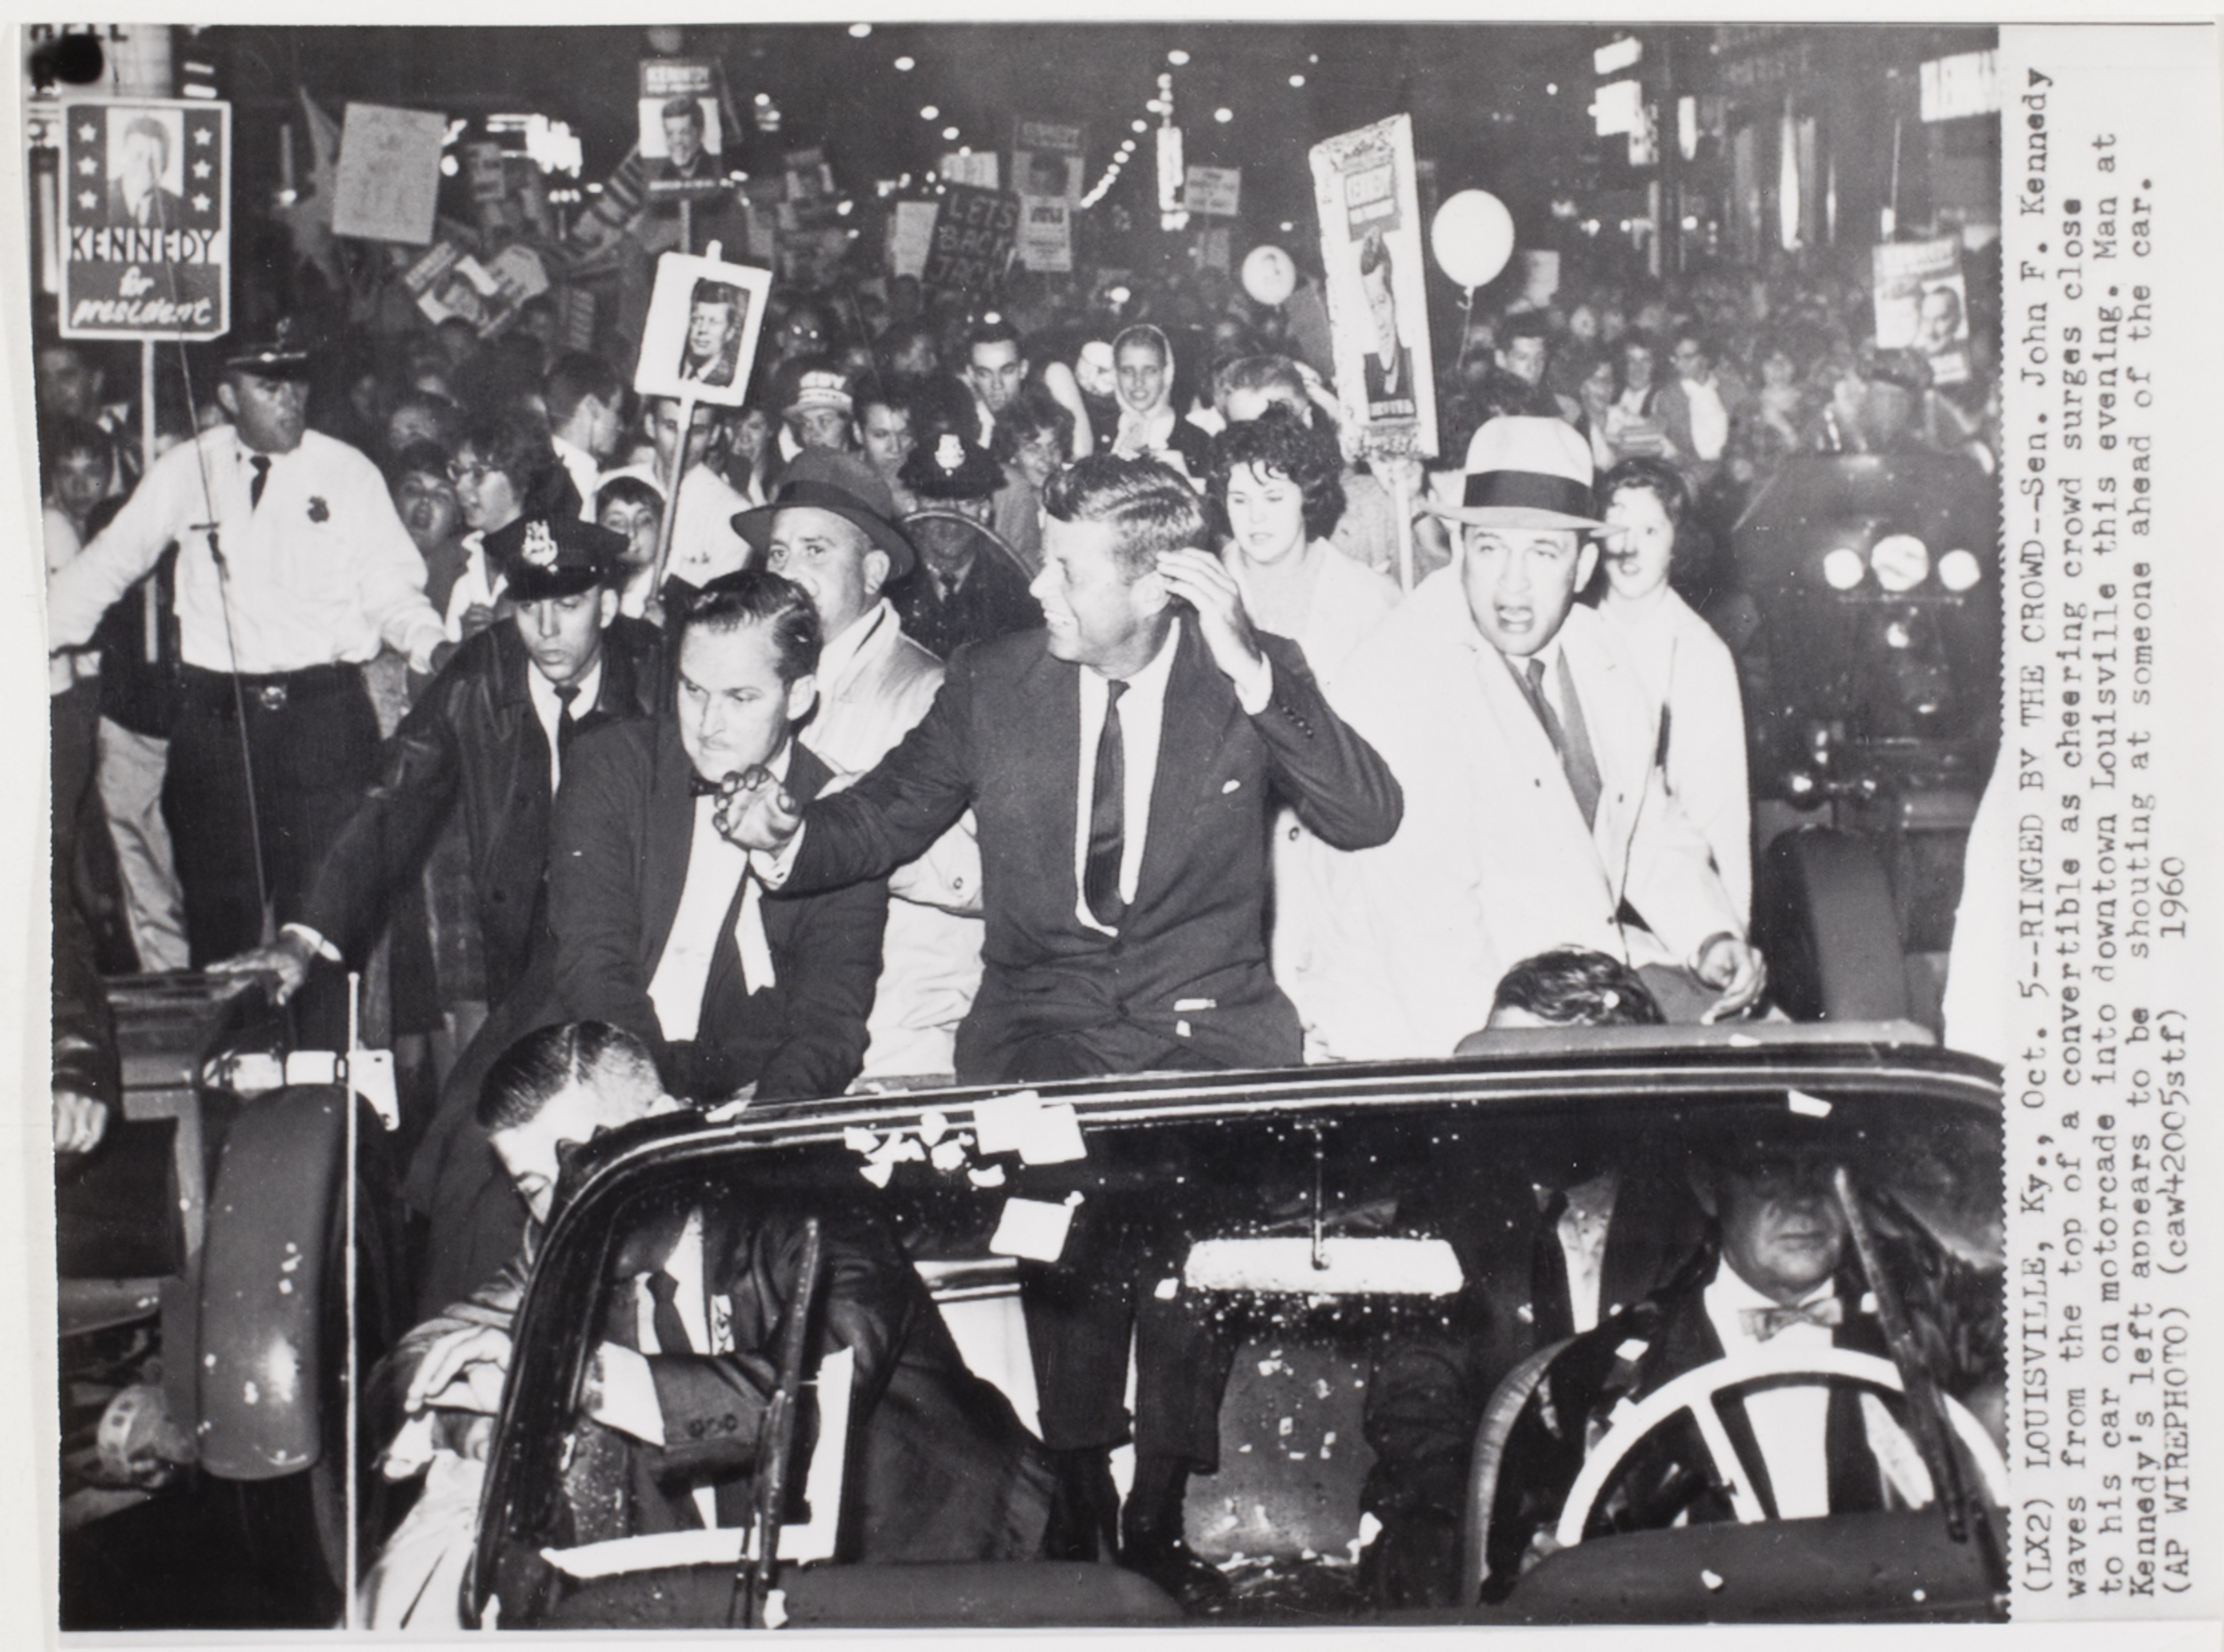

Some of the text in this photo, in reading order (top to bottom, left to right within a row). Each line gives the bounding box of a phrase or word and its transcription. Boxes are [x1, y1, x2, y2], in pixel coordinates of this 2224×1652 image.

[948, 192, 1016, 229] LETS
[70, 226, 215, 265] KENNEDY
[939, 224, 1012, 258] BACK
[119, 266, 156, 297] for
[71, 297, 213, 328] president
